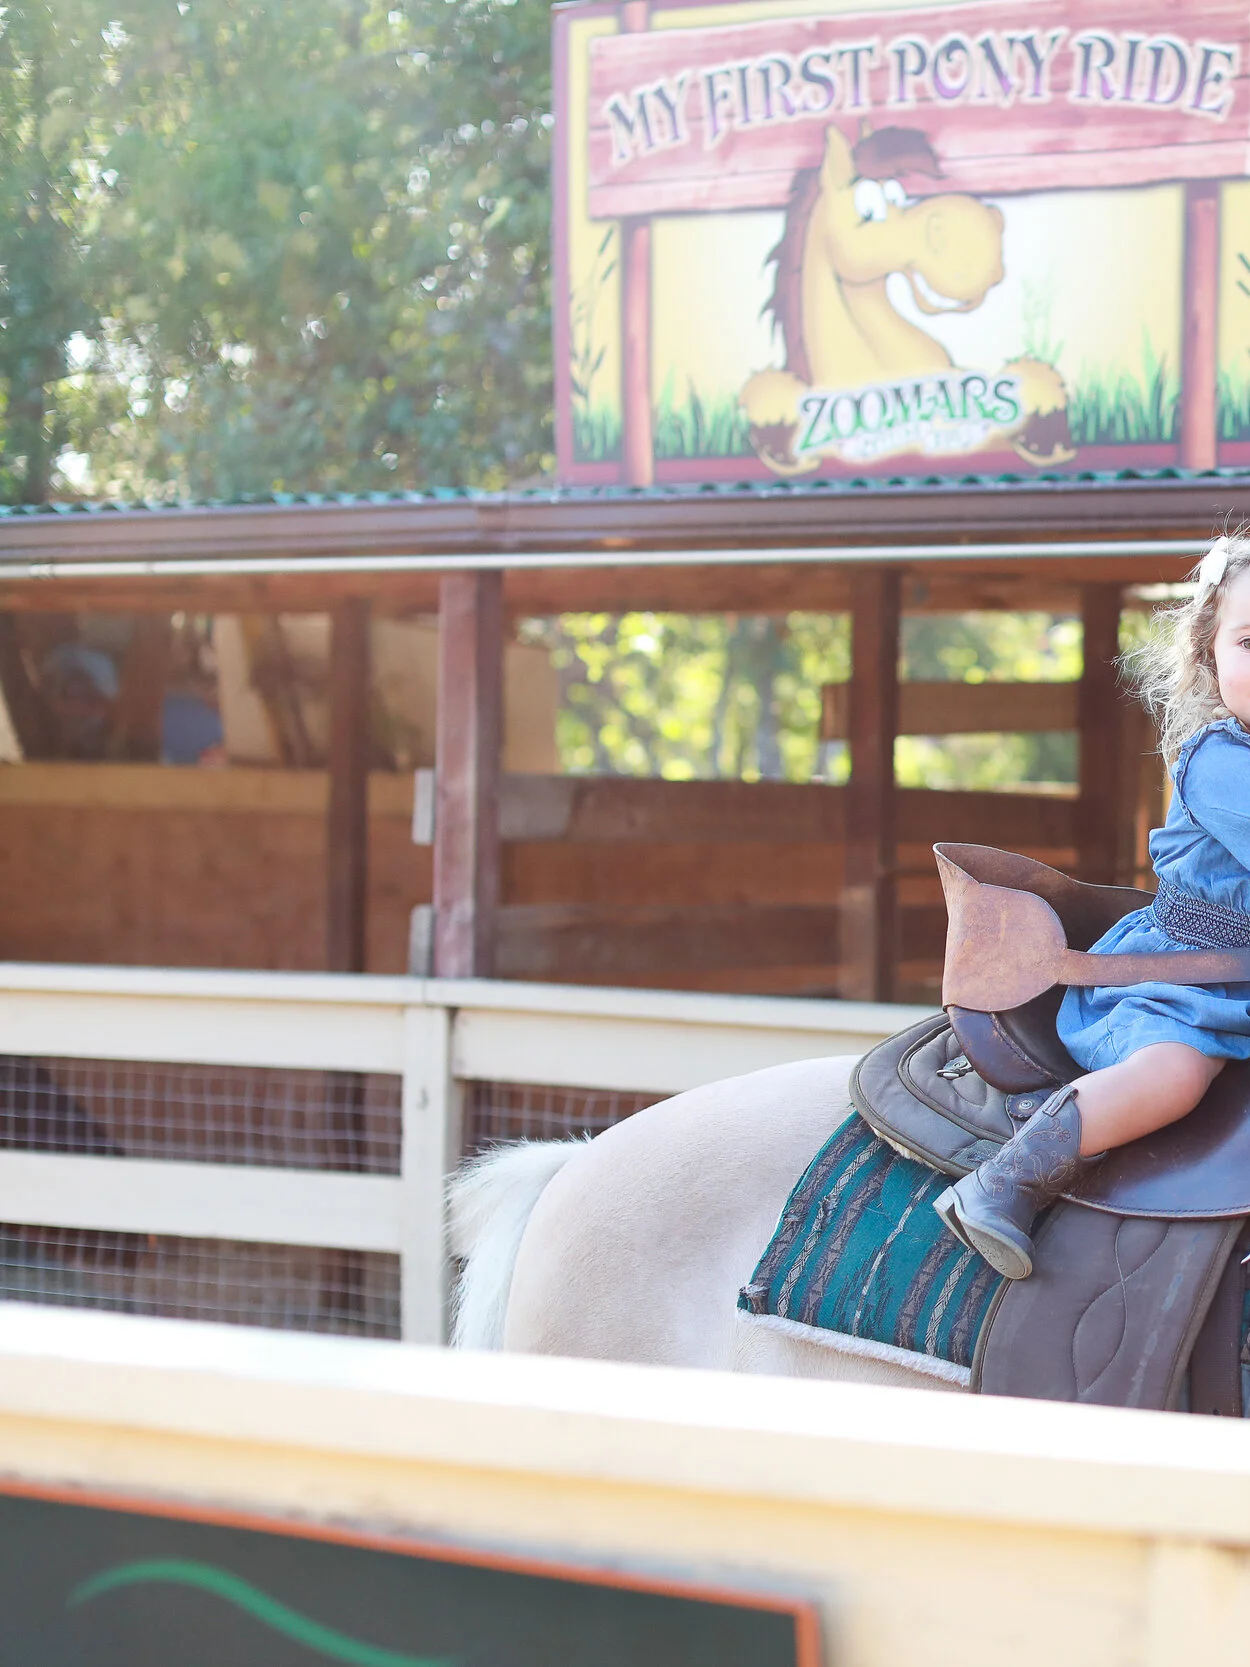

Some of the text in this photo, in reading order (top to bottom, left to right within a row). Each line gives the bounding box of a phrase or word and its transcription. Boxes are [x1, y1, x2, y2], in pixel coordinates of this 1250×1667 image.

[606, 32, 1236, 161] MY FIRST PONY RIDE
[798, 375, 1021, 452] ZOOMARS
